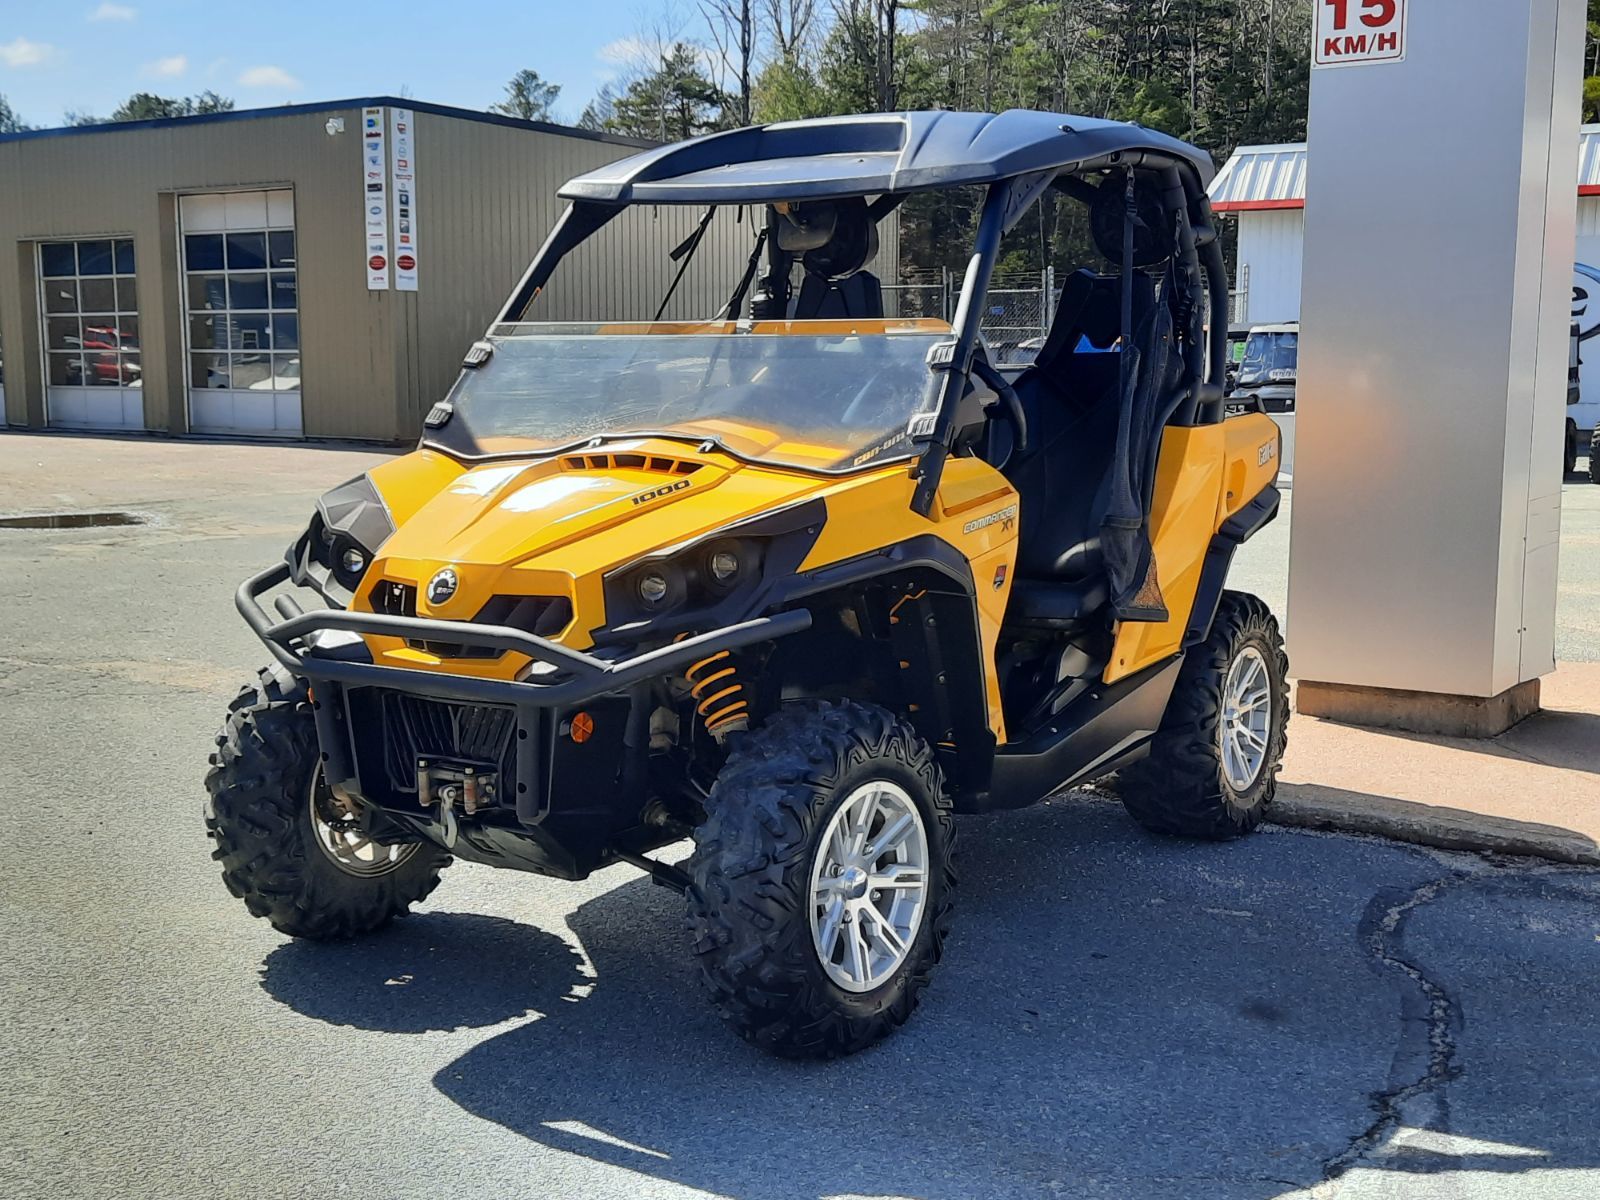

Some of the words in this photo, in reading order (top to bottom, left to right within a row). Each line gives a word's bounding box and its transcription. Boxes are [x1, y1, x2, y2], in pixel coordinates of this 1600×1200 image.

[1325, 0, 1396, 30] 15
[1324, 32, 1397, 56] KM/H
[632, 479, 690, 505] 1000
[436, 586, 454, 596] BRP
